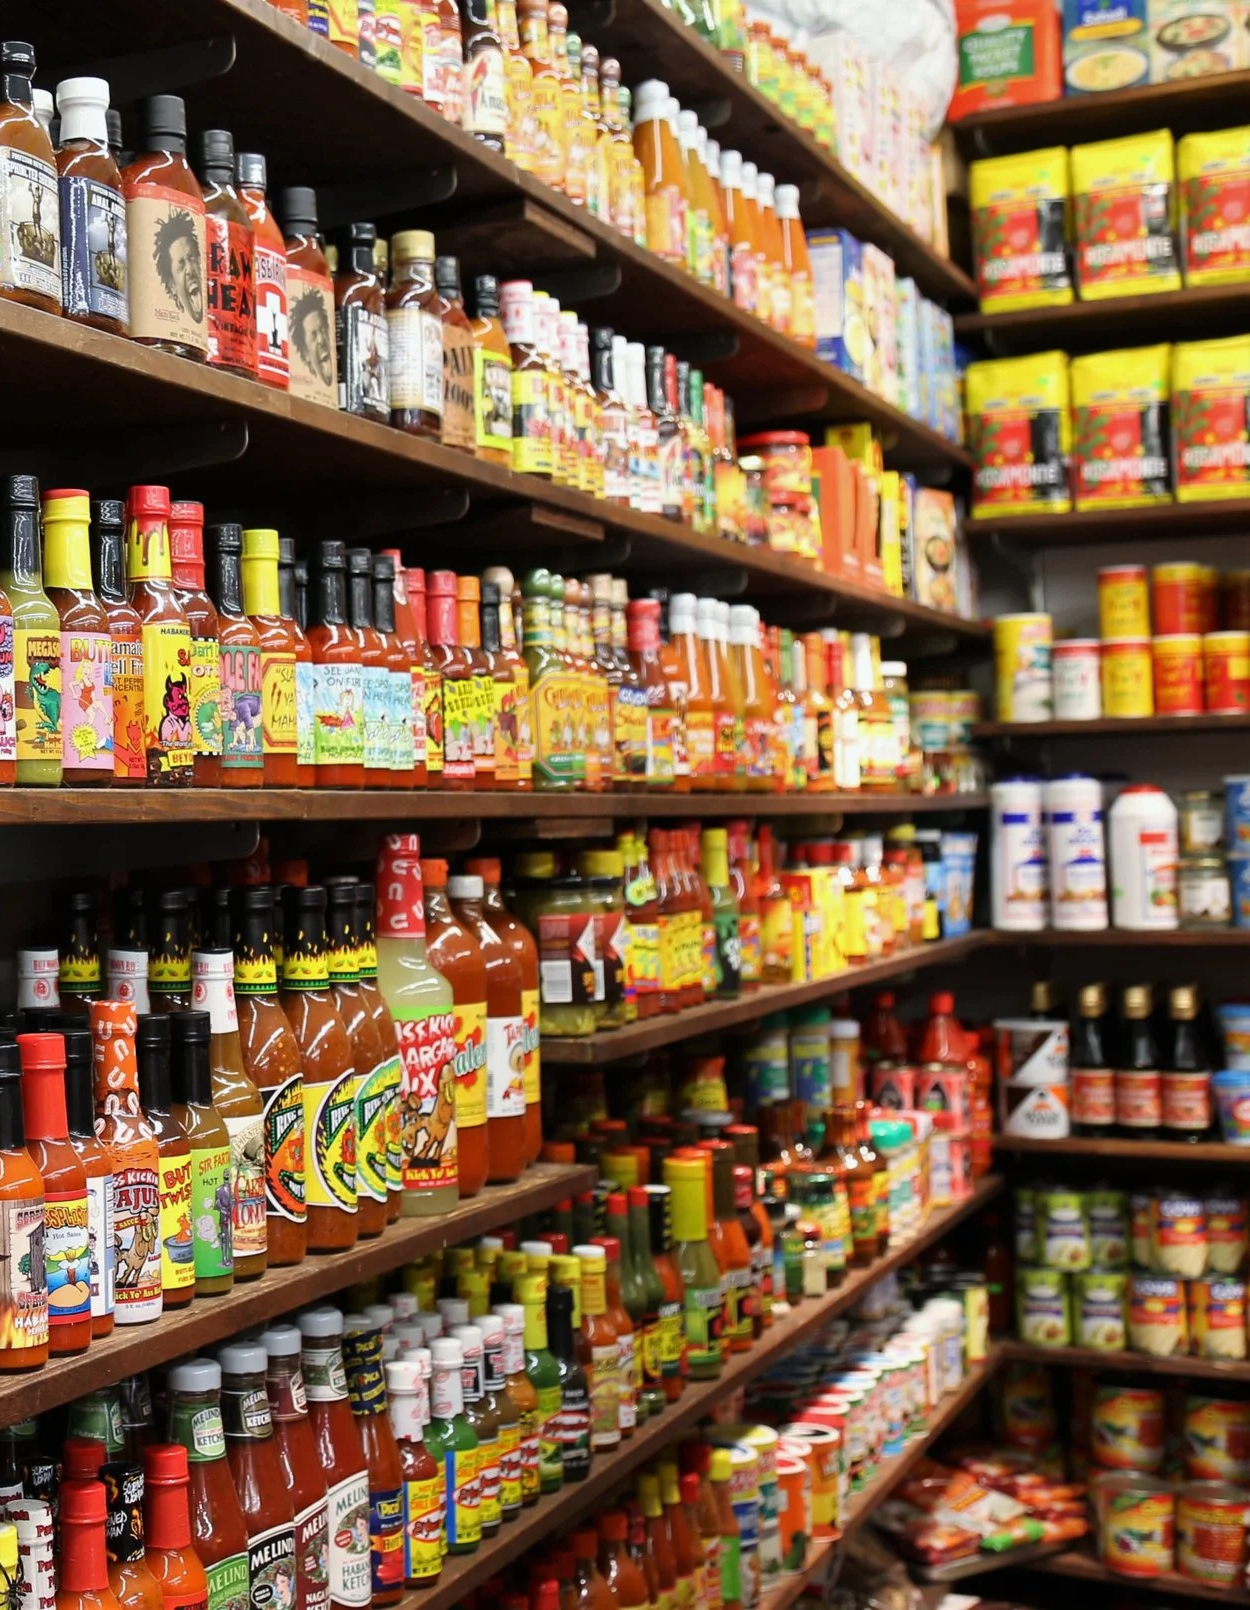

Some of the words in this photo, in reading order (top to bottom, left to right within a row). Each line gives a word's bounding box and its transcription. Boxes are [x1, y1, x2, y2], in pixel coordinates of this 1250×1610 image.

[324, 666, 342, 676] SEE
[327, 677, 344, 686] ON
[203, 1177, 218, 1186] HOT
[120, 1219, 139, 1228] SAUCE
